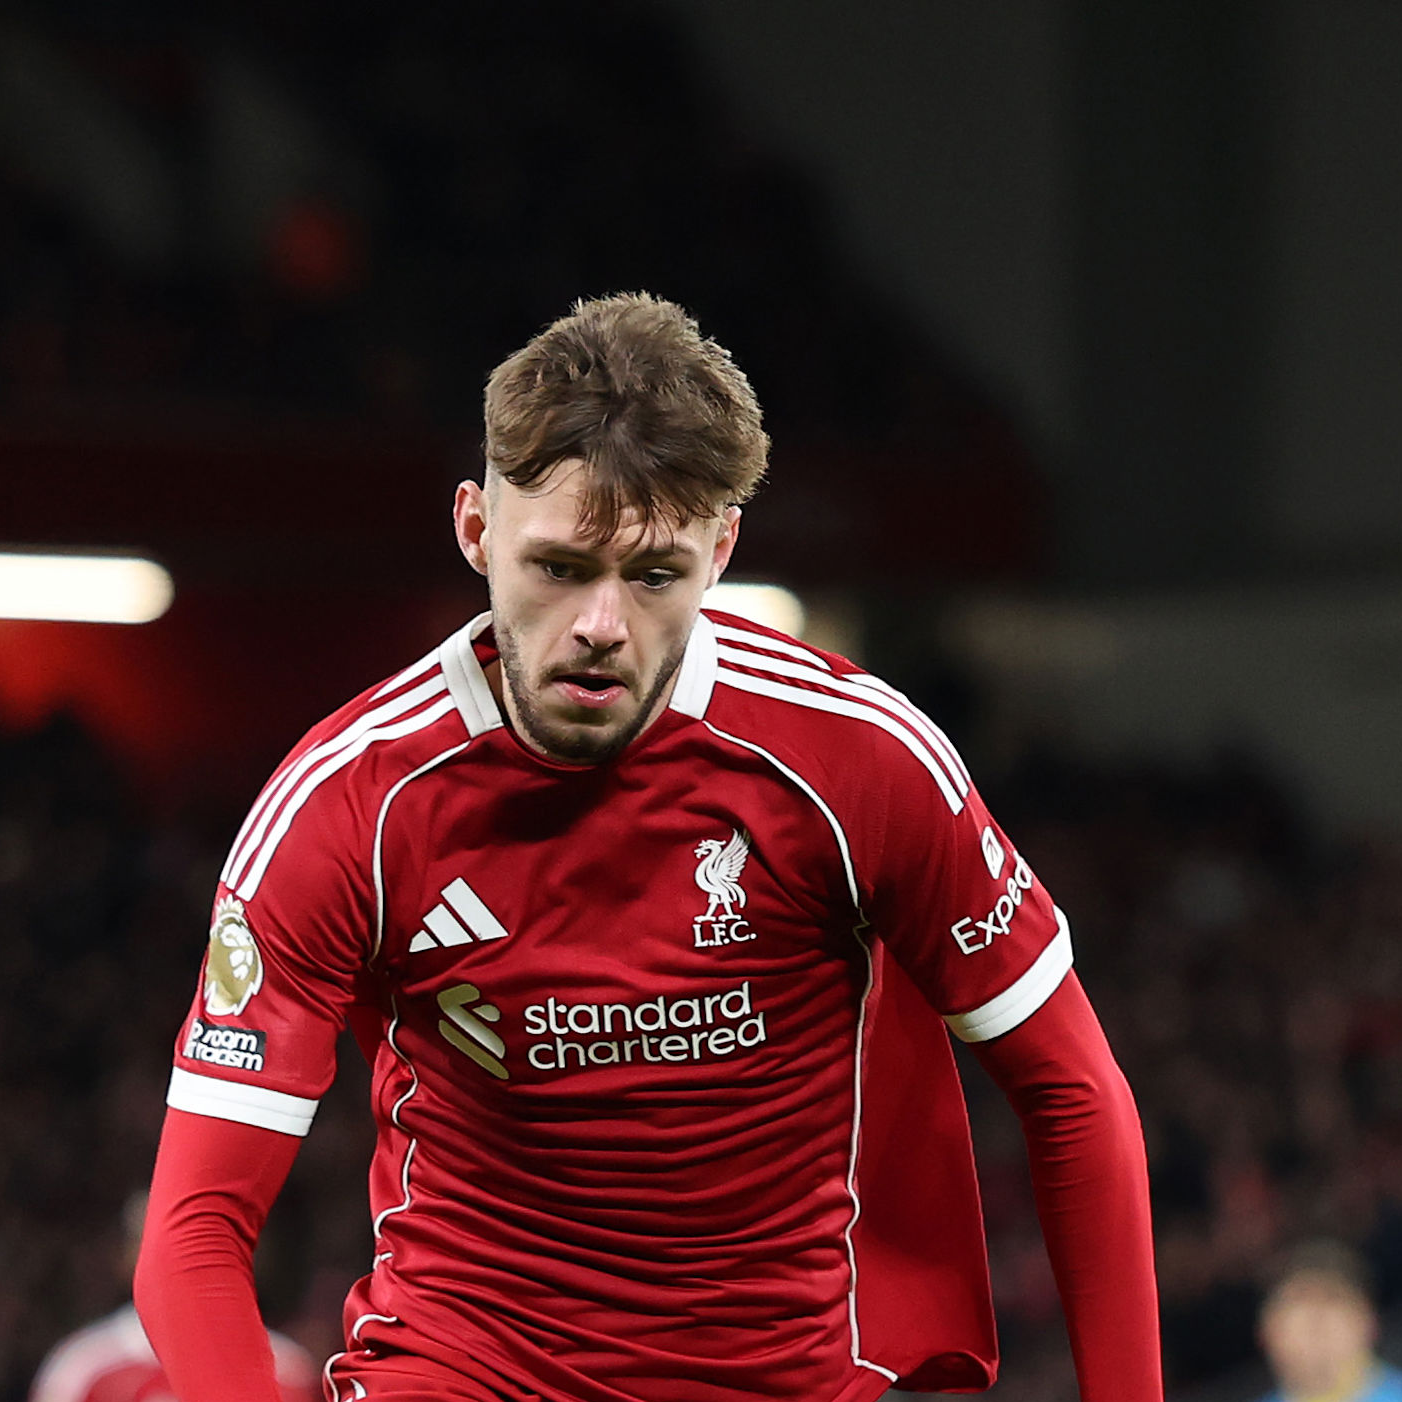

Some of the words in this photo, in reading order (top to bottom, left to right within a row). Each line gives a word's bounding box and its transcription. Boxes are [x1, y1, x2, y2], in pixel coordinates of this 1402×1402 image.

[951, 850, 1033, 955] Exped
[692, 920, 757, 947] L.F.C.
[524, 981, 751, 1035] standard
[202, 1029, 258, 1052] room
[527, 1012, 767, 1069] chartered
